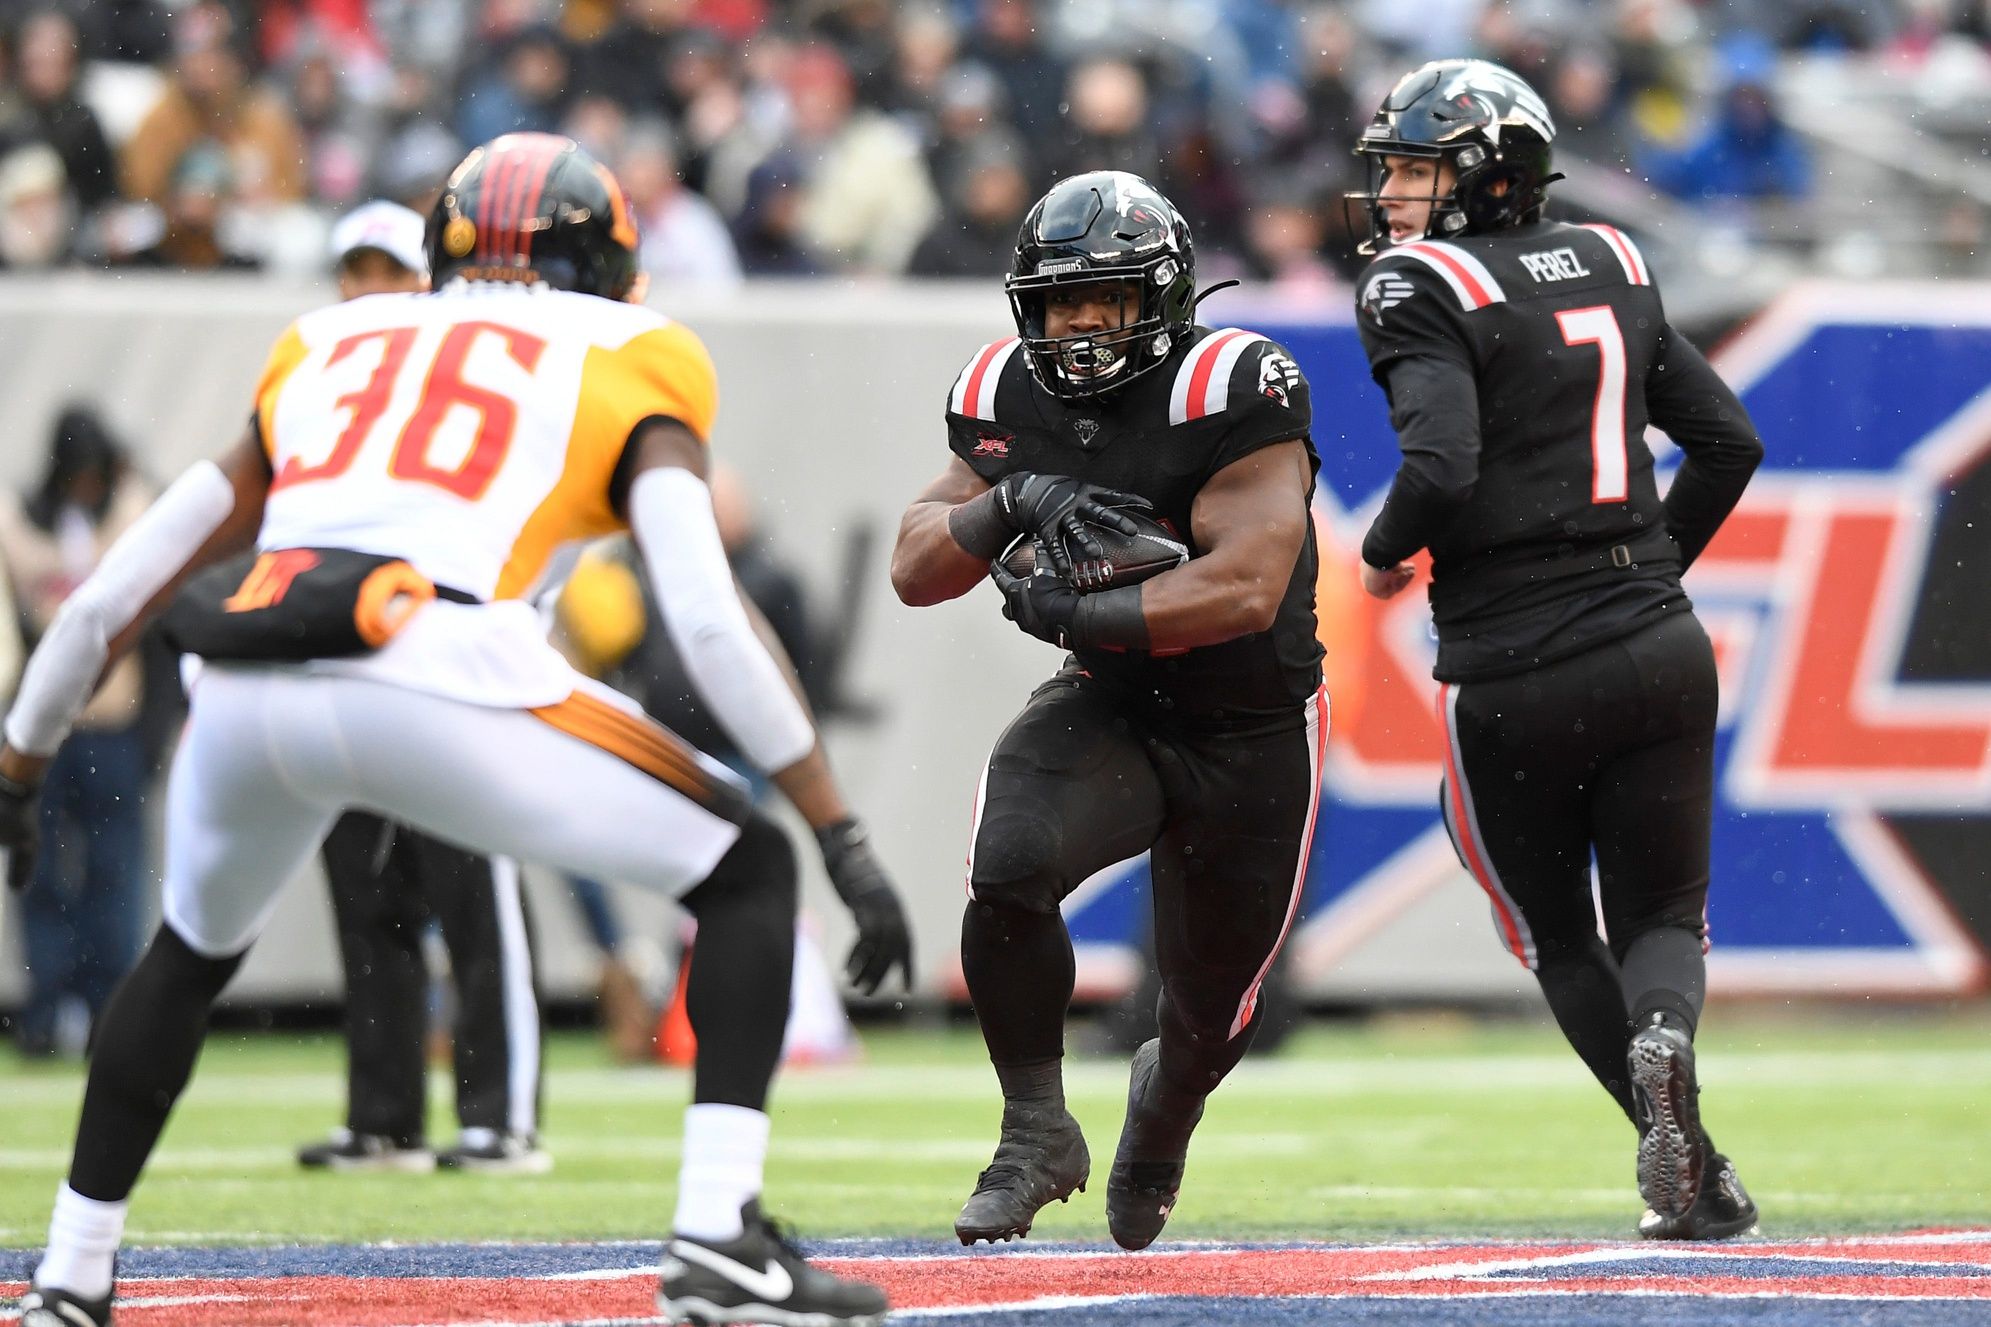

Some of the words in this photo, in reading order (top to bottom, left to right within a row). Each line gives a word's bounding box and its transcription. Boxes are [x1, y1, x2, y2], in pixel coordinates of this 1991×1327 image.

[1519, 248, 1590, 283] PEREZ
[269, 321, 548, 502] 36
[1553, 305, 1629, 504] 7
